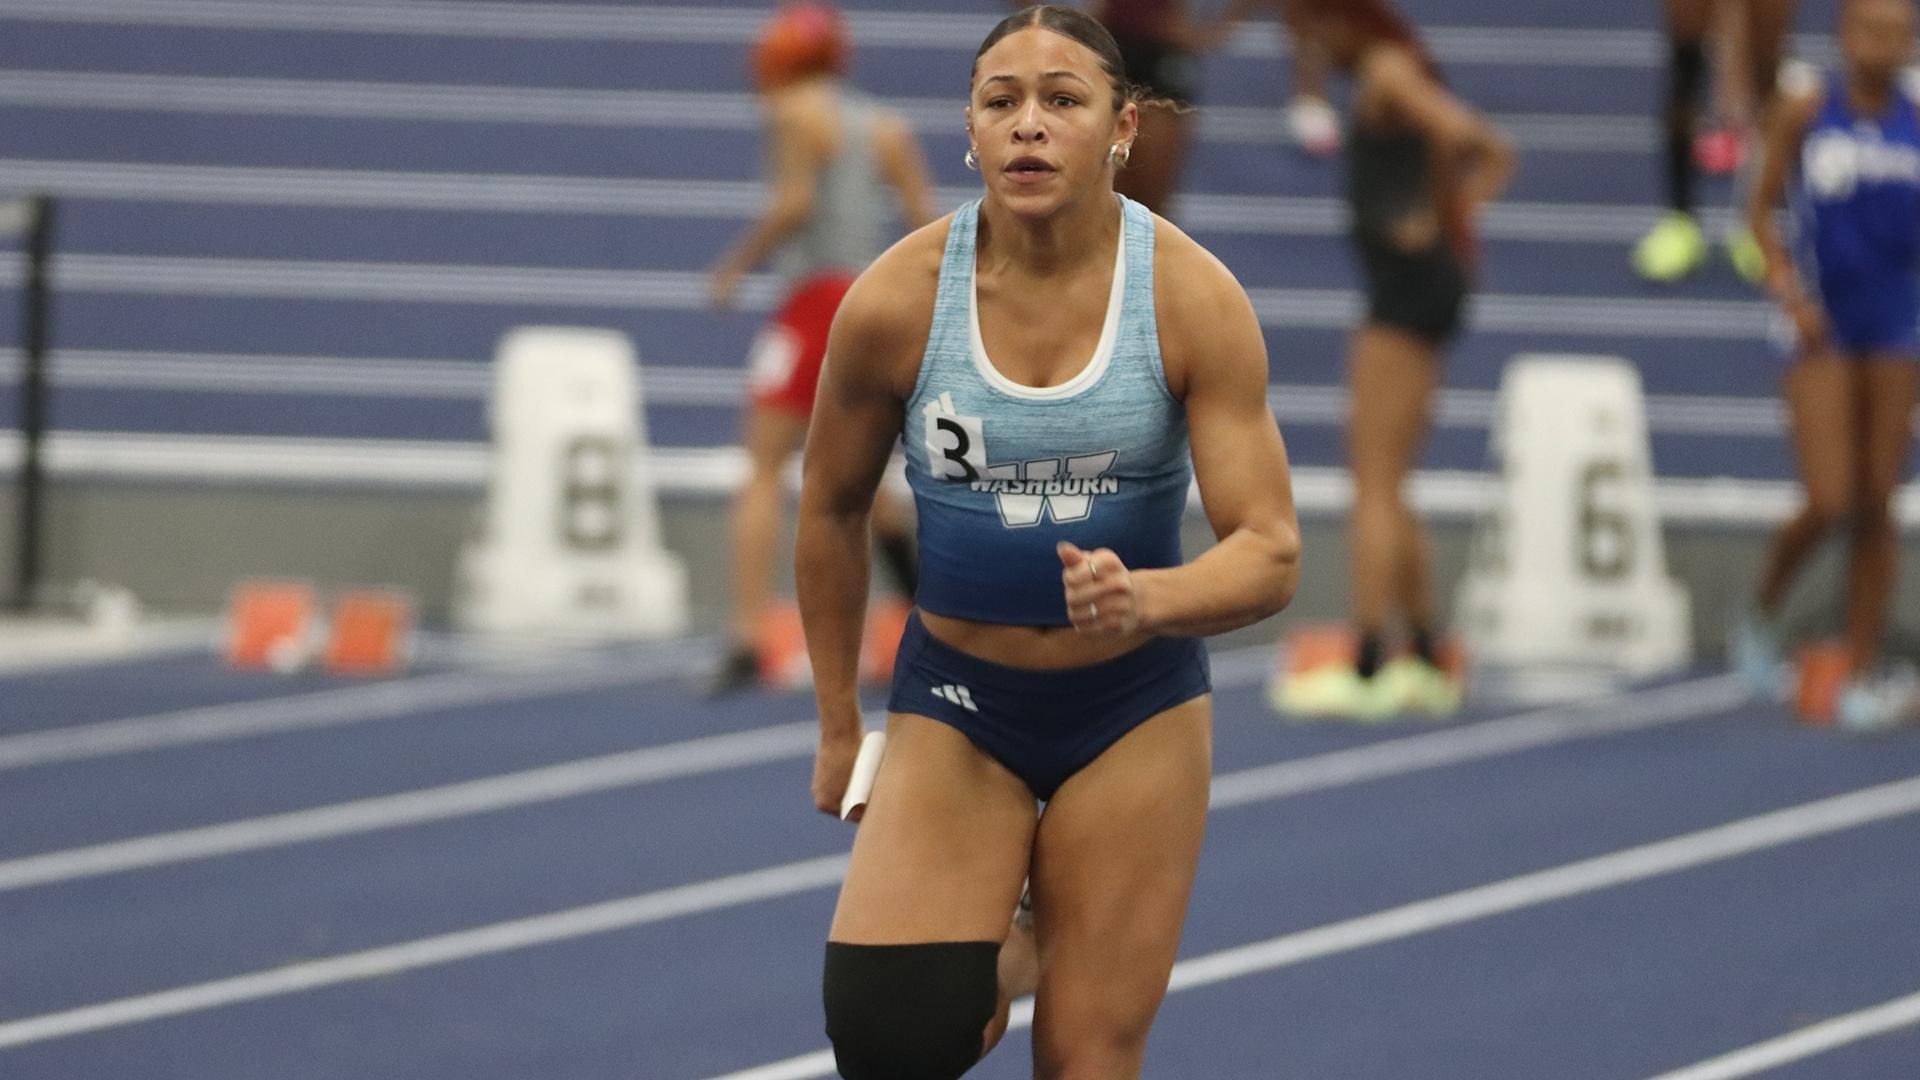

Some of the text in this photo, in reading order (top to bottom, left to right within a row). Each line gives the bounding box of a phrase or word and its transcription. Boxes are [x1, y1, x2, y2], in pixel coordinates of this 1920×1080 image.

[936, 417, 981, 482] 3
[970, 475, 1120, 496] WASHBURN
[985, 449, 1120, 529] W
[559, 434, 626, 551] 8
[1573, 460, 1635, 580] 6
